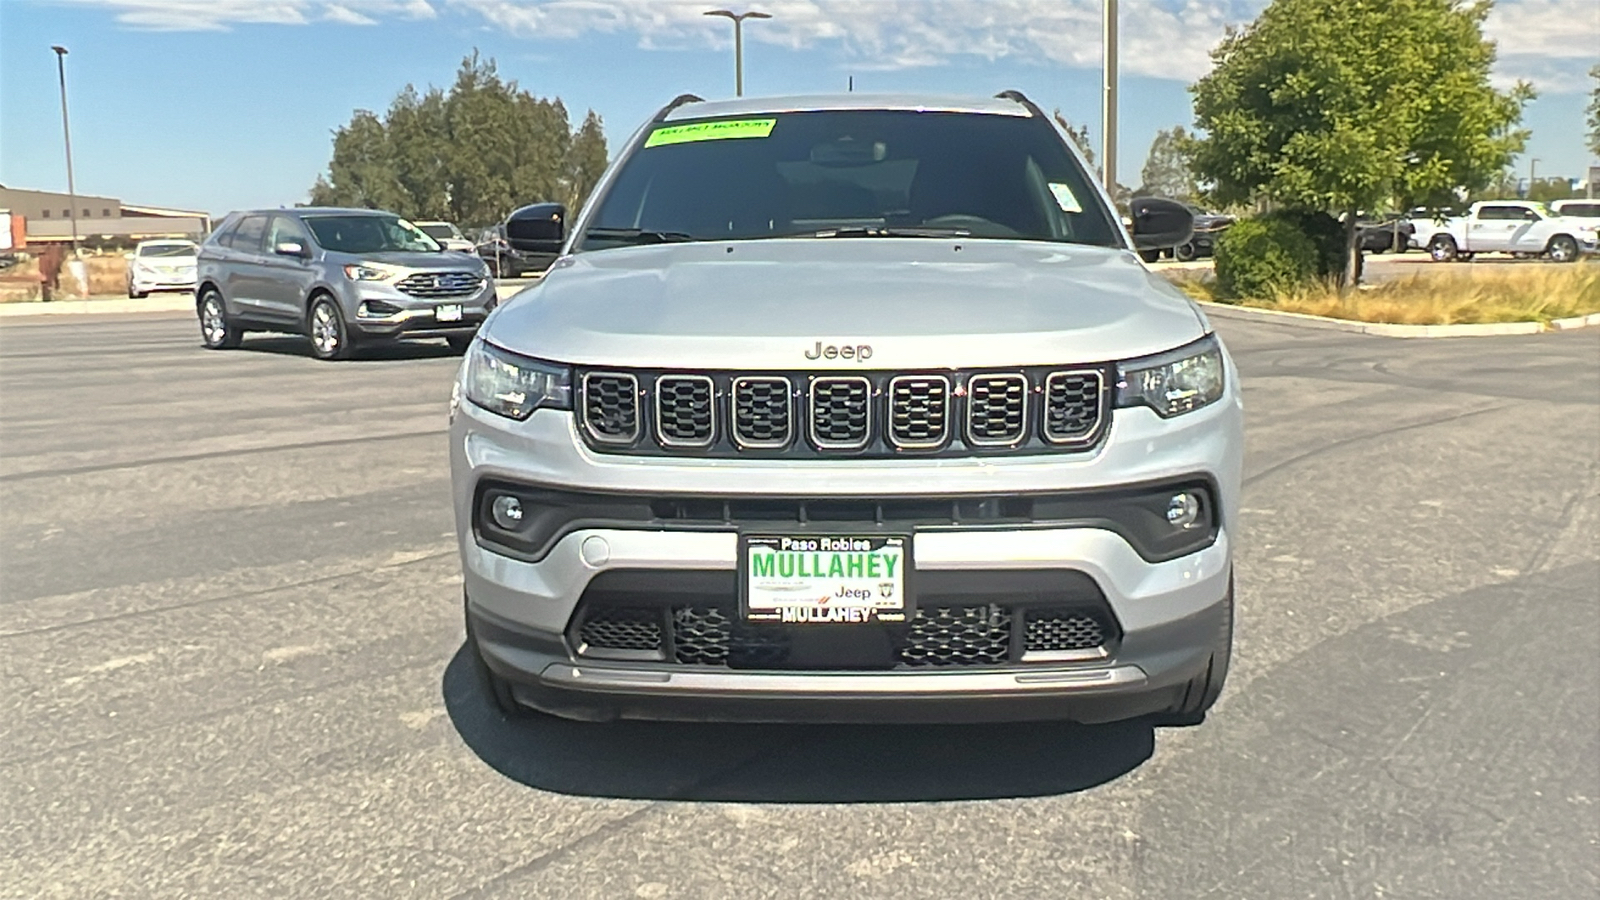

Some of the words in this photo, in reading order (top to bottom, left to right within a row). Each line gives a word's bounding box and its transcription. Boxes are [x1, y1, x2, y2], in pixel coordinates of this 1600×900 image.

[804, 341, 873, 363] Jeep
[781, 538, 817, 551] Paso
[820, 538, 871, 551] Robles
[753, 553, 899, 578] MULLAHEY
[835, 586, 871, 600] Jeep
[782, 607, 871, 623] MULLAHEY
